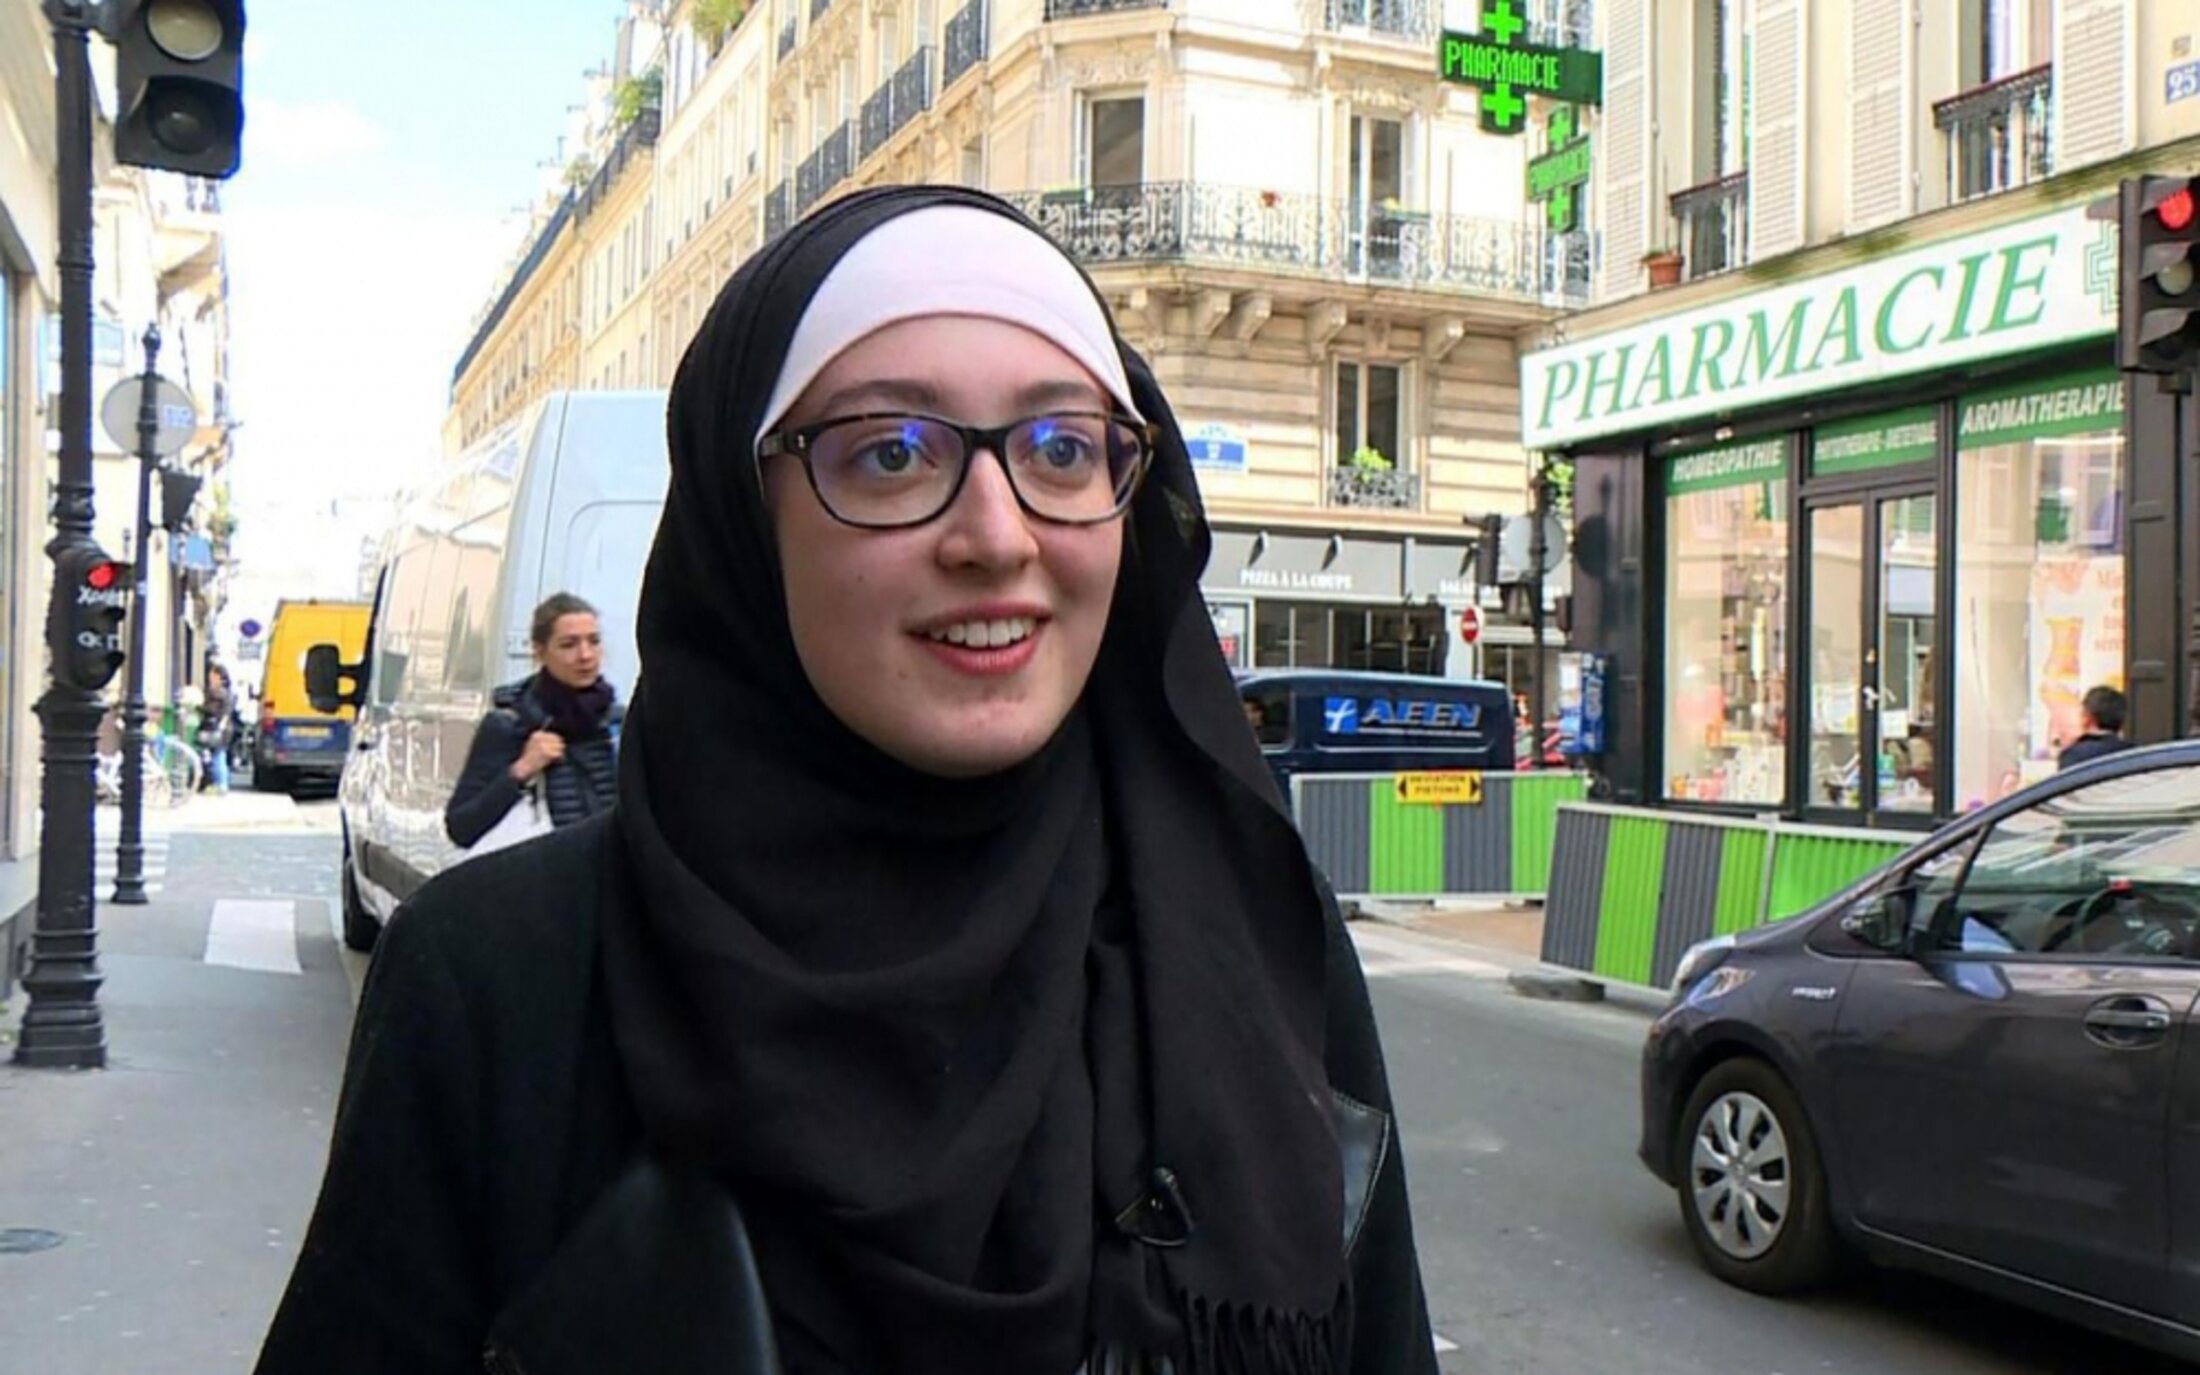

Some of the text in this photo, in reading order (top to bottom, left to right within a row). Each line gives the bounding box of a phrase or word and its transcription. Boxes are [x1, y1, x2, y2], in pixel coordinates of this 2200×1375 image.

[1445, 40, 1559, 91] PHARMACIE
[1536, 232, 2059, 430] PHARMACIE
[1959, 380, 2125, 435] AROMATHERAPIE
[1672, 439, 1783, 483] HOMEOPATHIE
